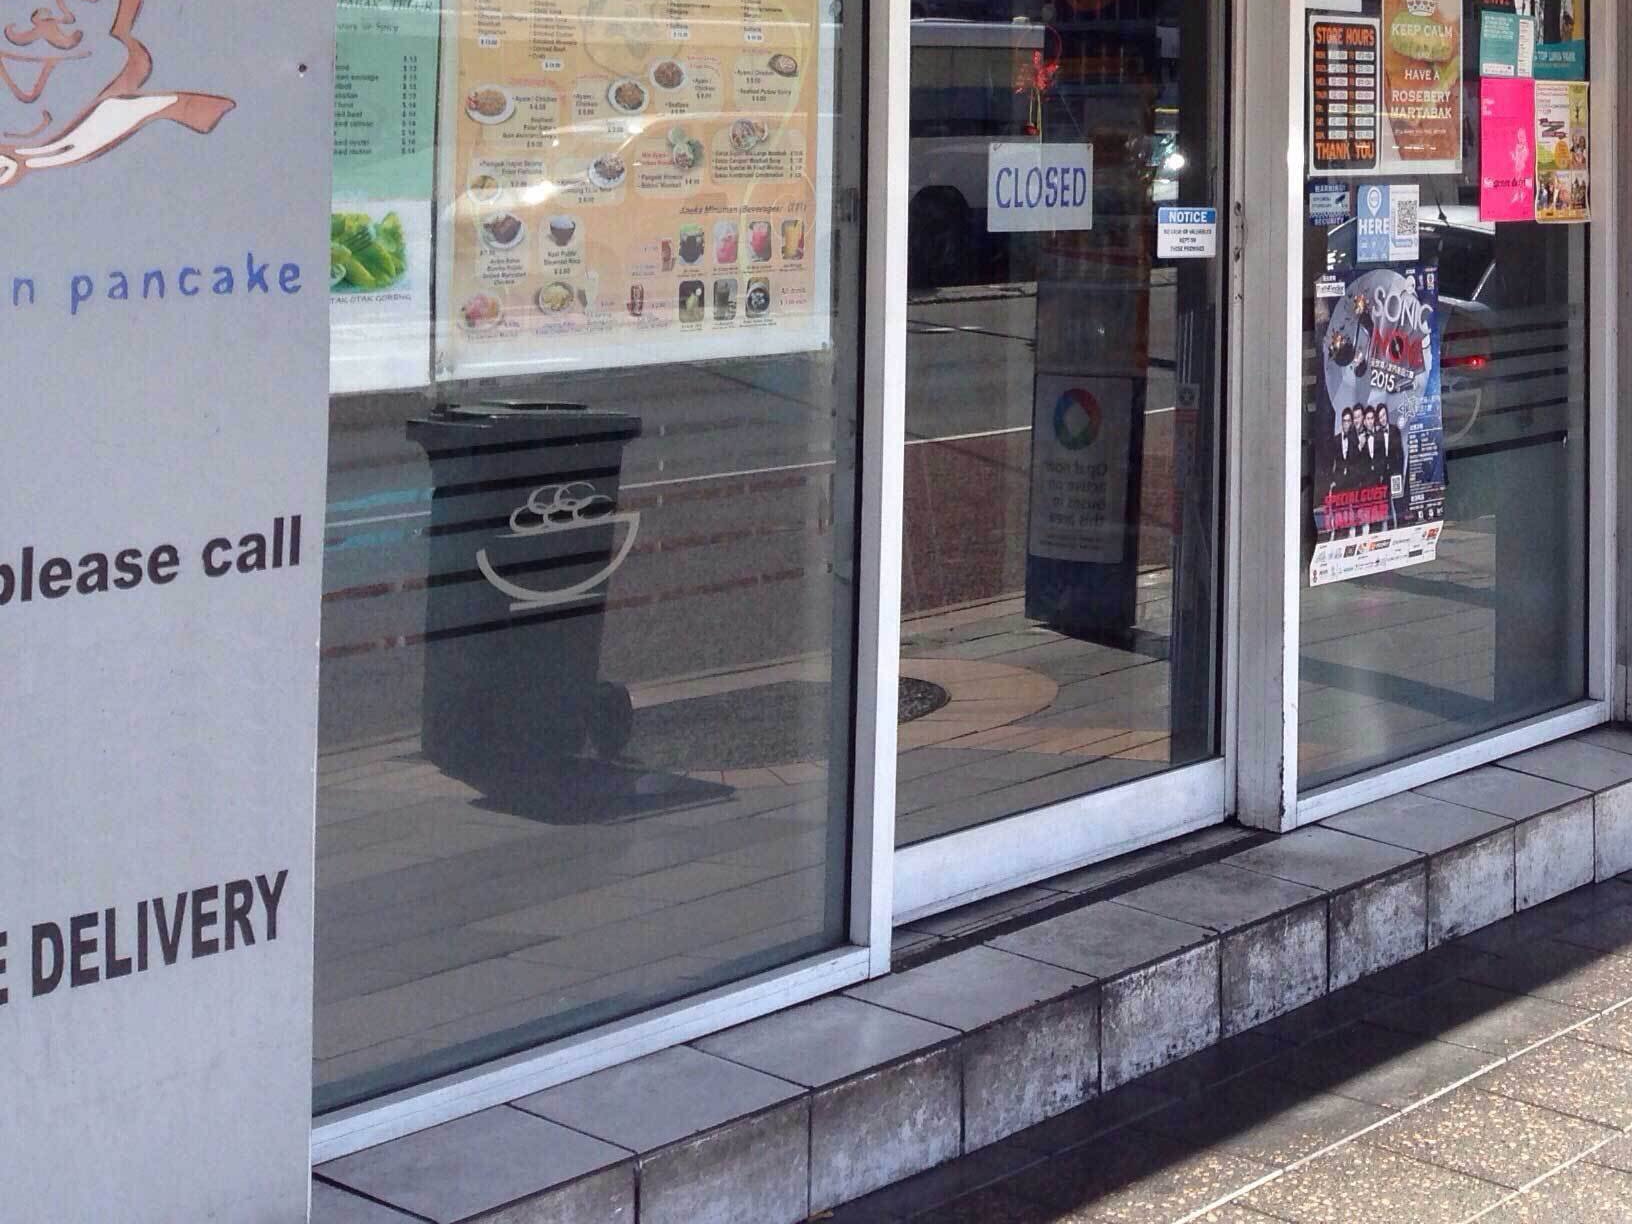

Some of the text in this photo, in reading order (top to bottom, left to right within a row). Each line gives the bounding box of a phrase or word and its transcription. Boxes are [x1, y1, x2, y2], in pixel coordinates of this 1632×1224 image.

[1316, 26, 1374, 46] STORE HOURS
[1392, 24, 1453, 39] KEEP CALM
[1405, 69, 1441, 80] HAVE A
[1392, 90, 1451, 102] ROSEBERY
[1316, 142, 1350, 160] THANK
[996, 167, 1087, 209] CLOSED
[1169, 211, 1208, 223] NOTICE
[1359, 218, 1390, 235] HERE
[71, 251, 302, 314] pancake
[1370, 369, 1395, 393] 2015
[202, 514, 302, 577] call
[31, 869, 289, 998] DELIVERY
